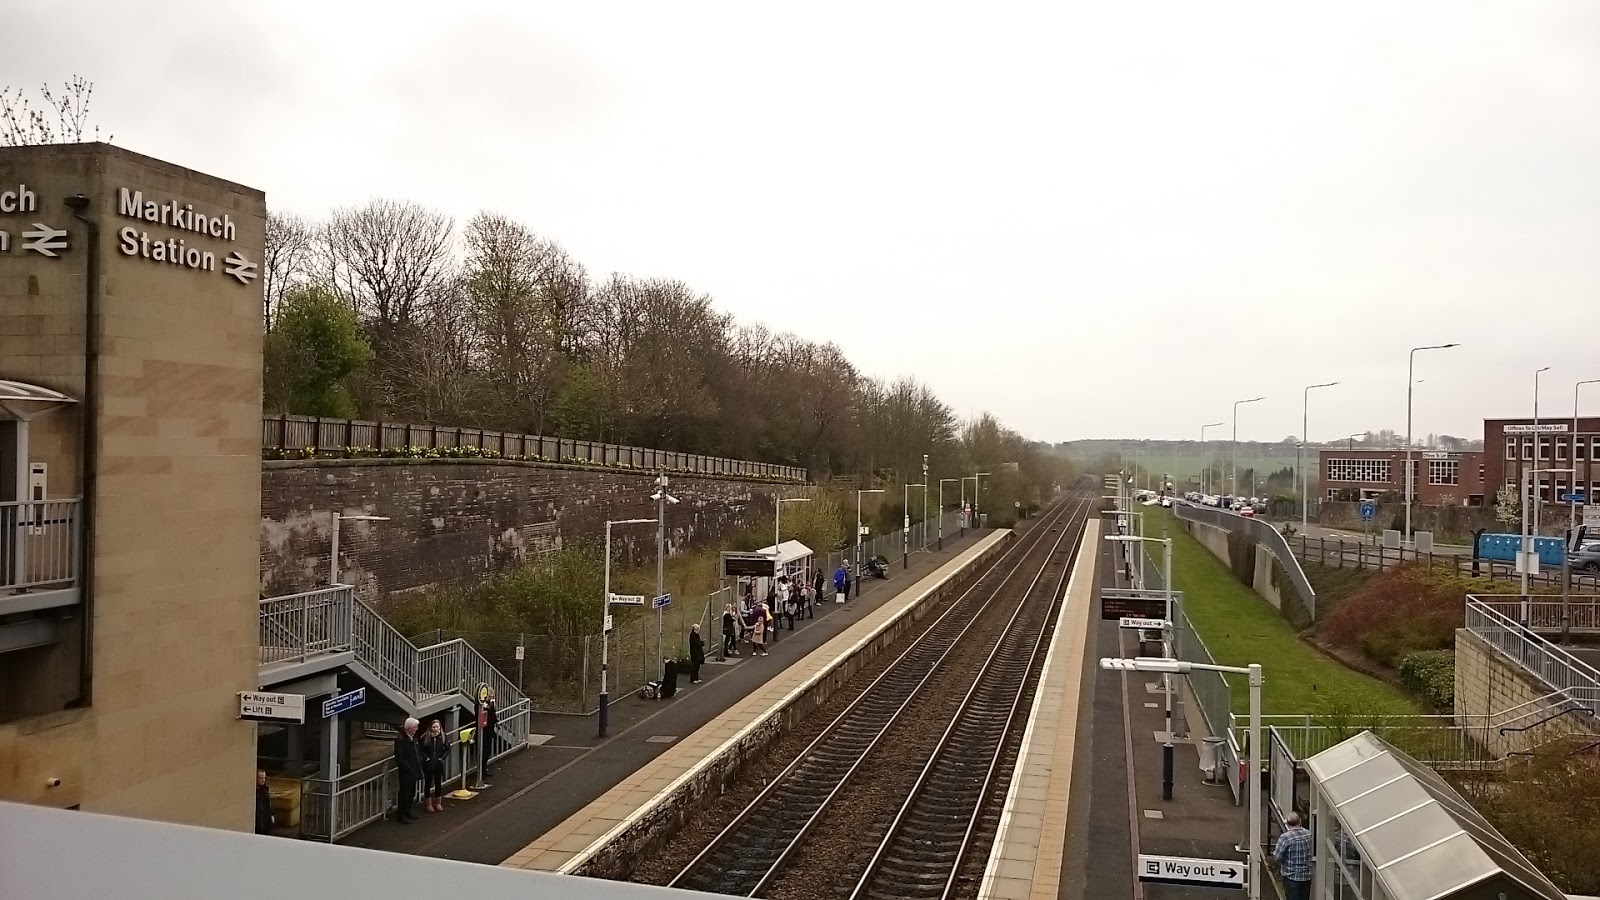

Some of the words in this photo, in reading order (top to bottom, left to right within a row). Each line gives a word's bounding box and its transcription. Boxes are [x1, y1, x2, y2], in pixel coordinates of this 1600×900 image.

[118, 186, 237, 242] Markinch
[119, 226, 217, 272] Station
[252, 695, 266, 704] Way
[252, 706, 264, 714] Lift
[1165, 861, 1191, 877] Way
[1193, 865, 1216, 876] out
